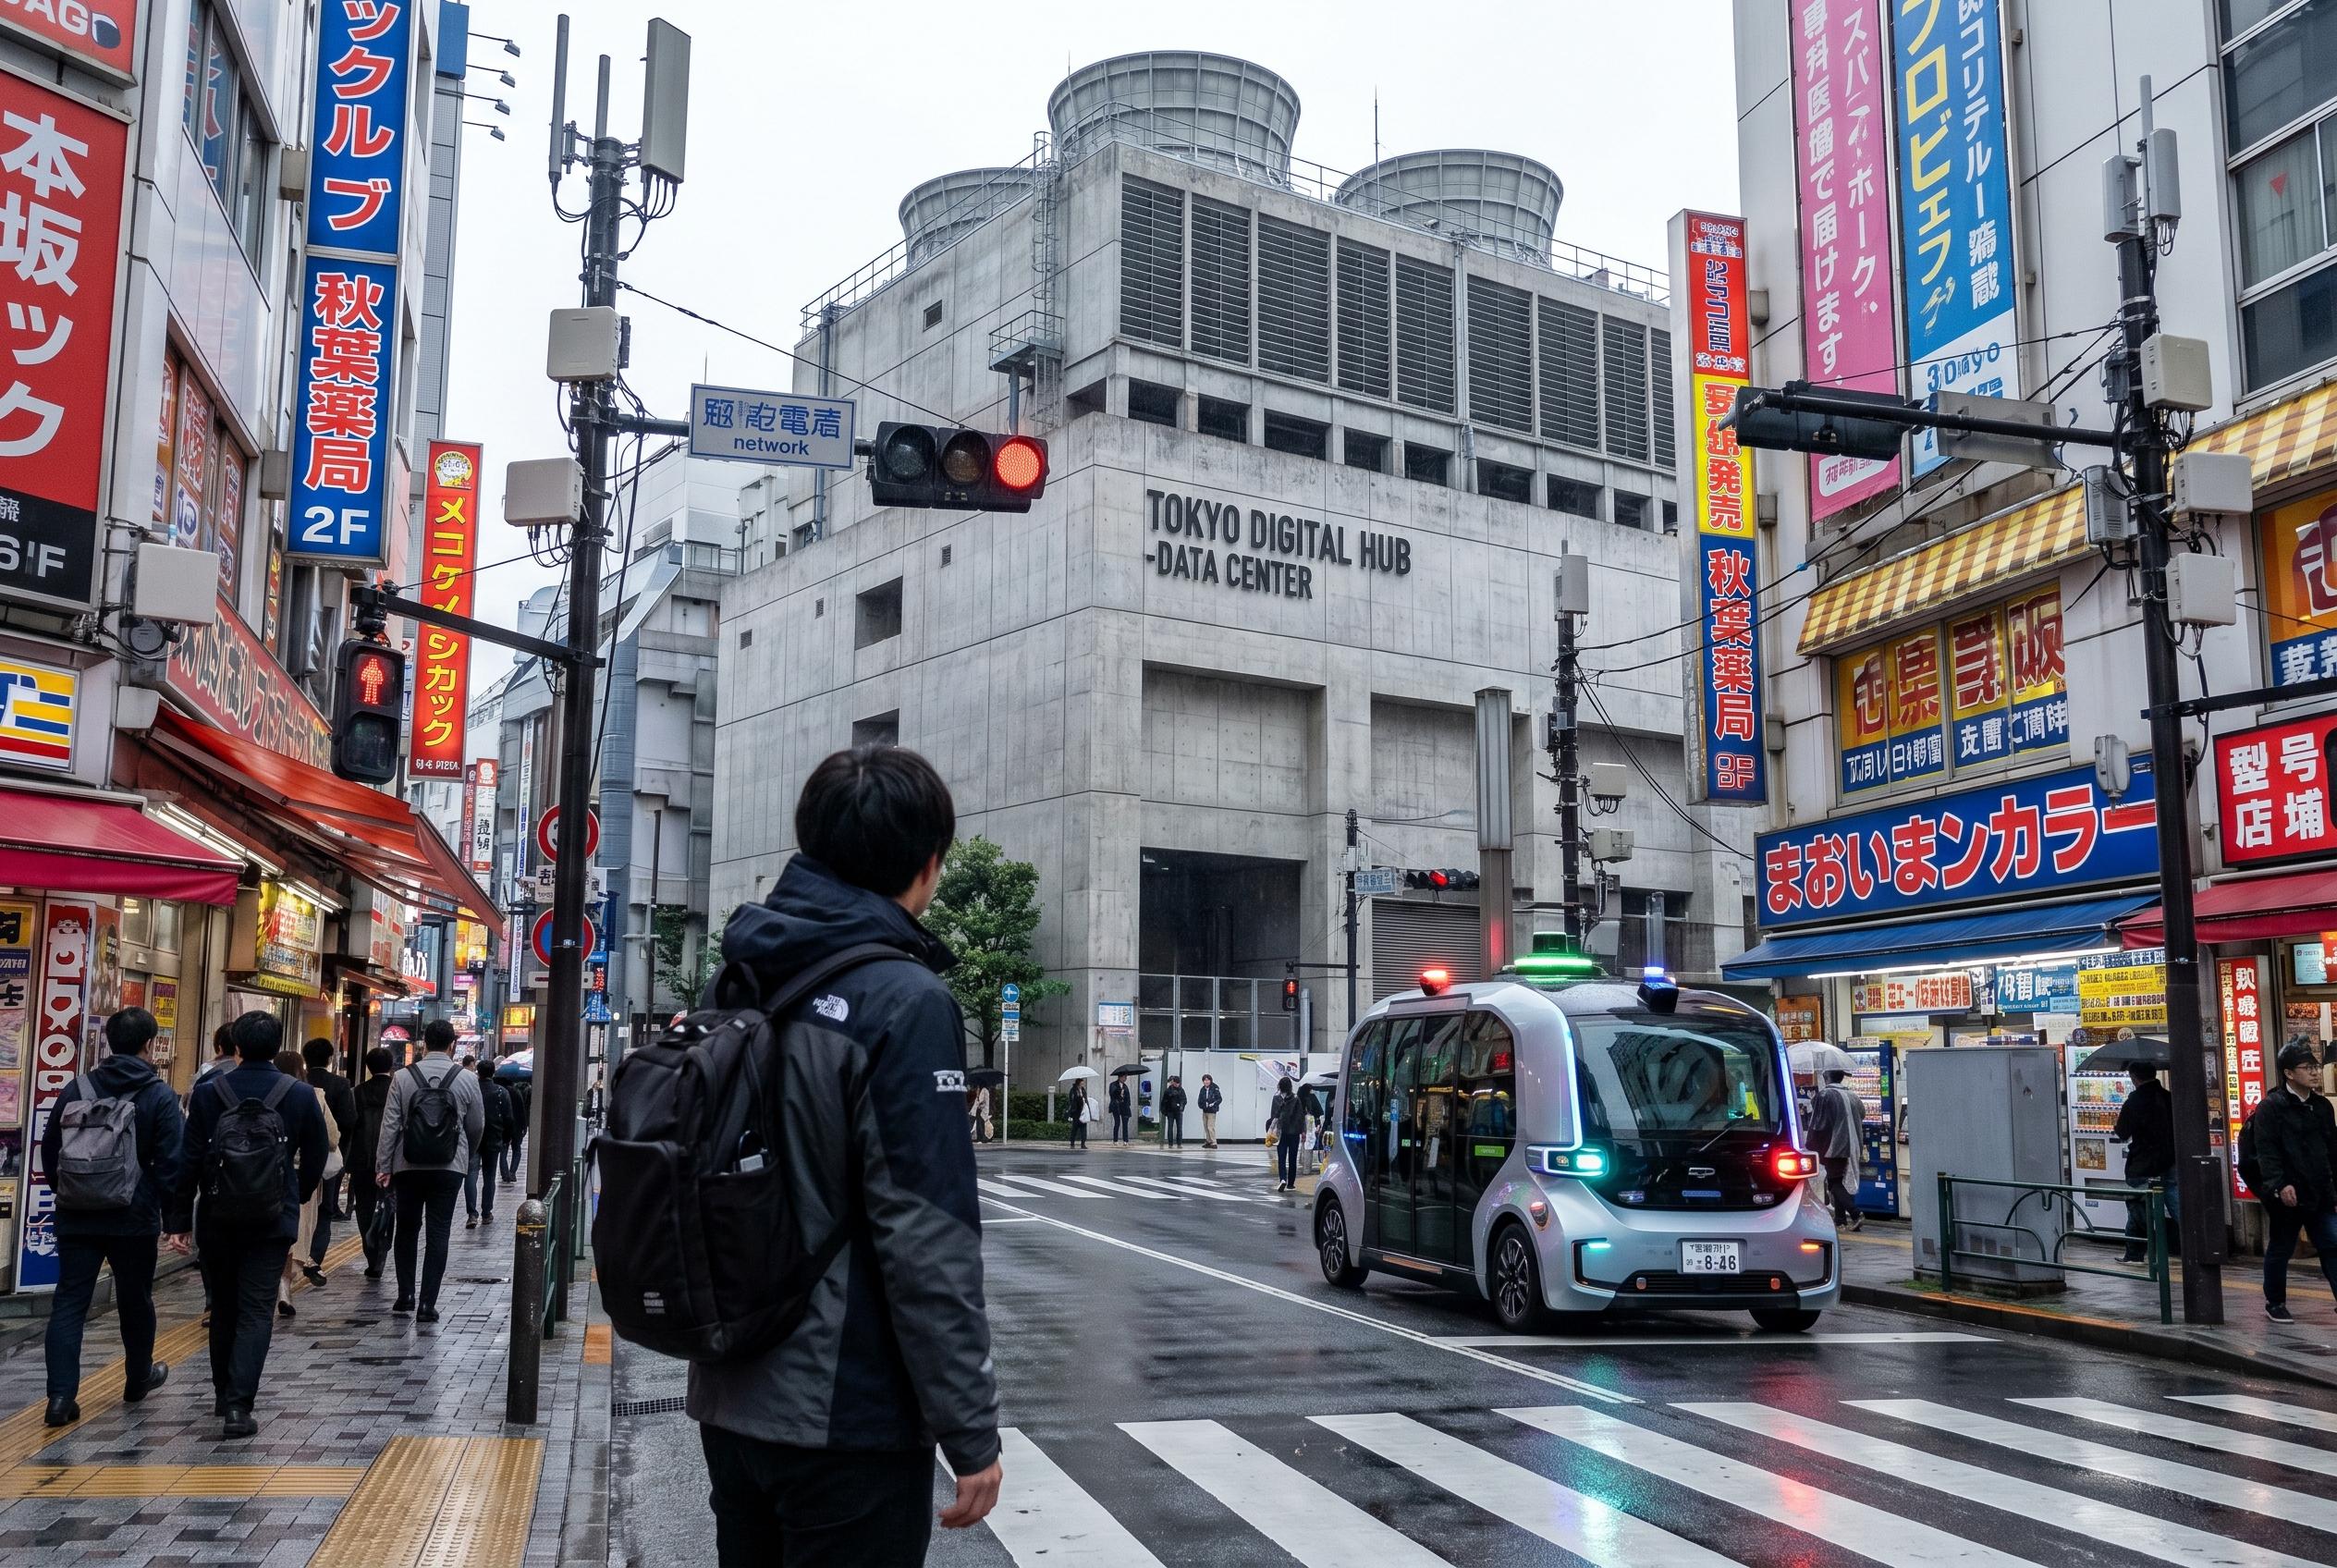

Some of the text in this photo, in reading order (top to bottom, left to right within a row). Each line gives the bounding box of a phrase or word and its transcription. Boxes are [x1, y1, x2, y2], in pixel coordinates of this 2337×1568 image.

[302, 272, 384, 495] 秋葉薬局
[734, 437, 809, 456] network
[302, 506, 370, 545] 2F
[1146, 488, 1411, 576] TOKYO DIGITAL HUB
[1226, 553, 1313, 600] CENTER
[1707, 548, 1755, 741] 秋葉薬局
